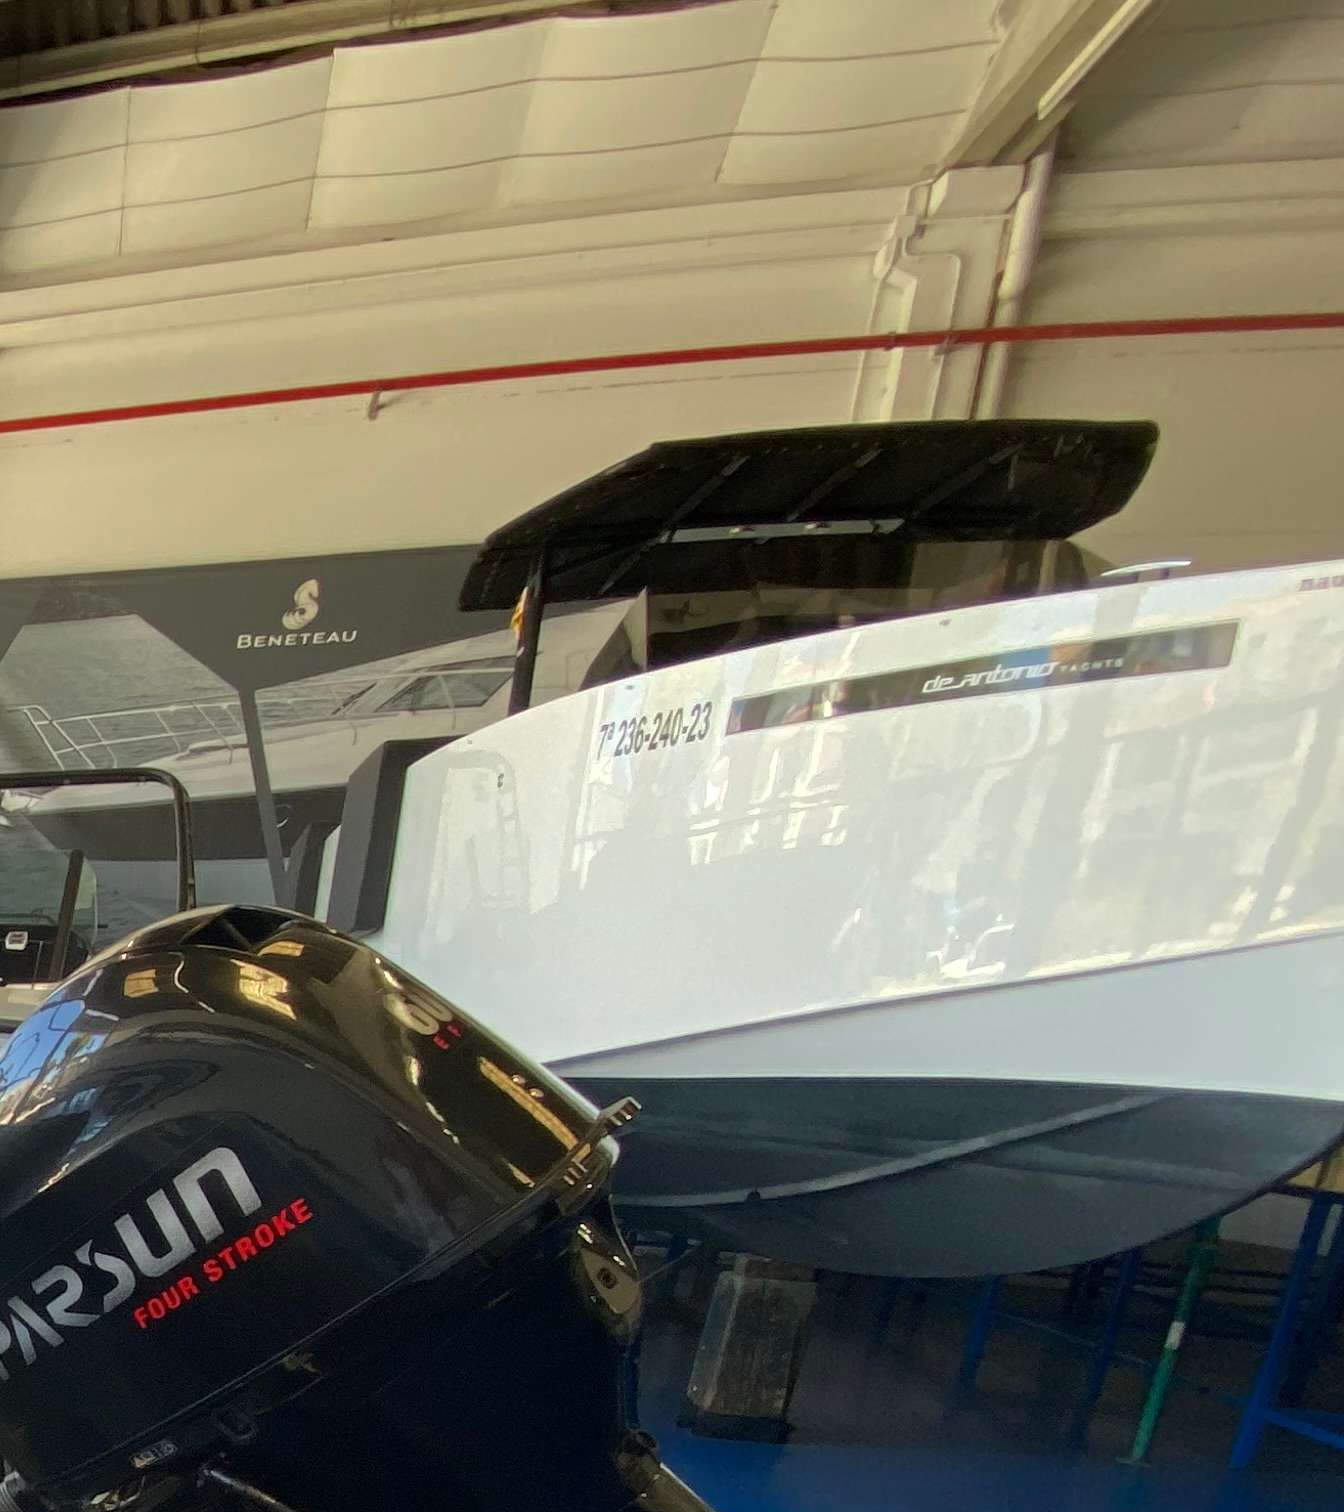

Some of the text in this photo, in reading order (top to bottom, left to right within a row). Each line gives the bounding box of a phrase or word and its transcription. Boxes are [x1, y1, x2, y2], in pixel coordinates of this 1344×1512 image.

[614, 701, 713, 757] 236-240-23
[133, 1197, 313, 1329] FOUR STROKE
